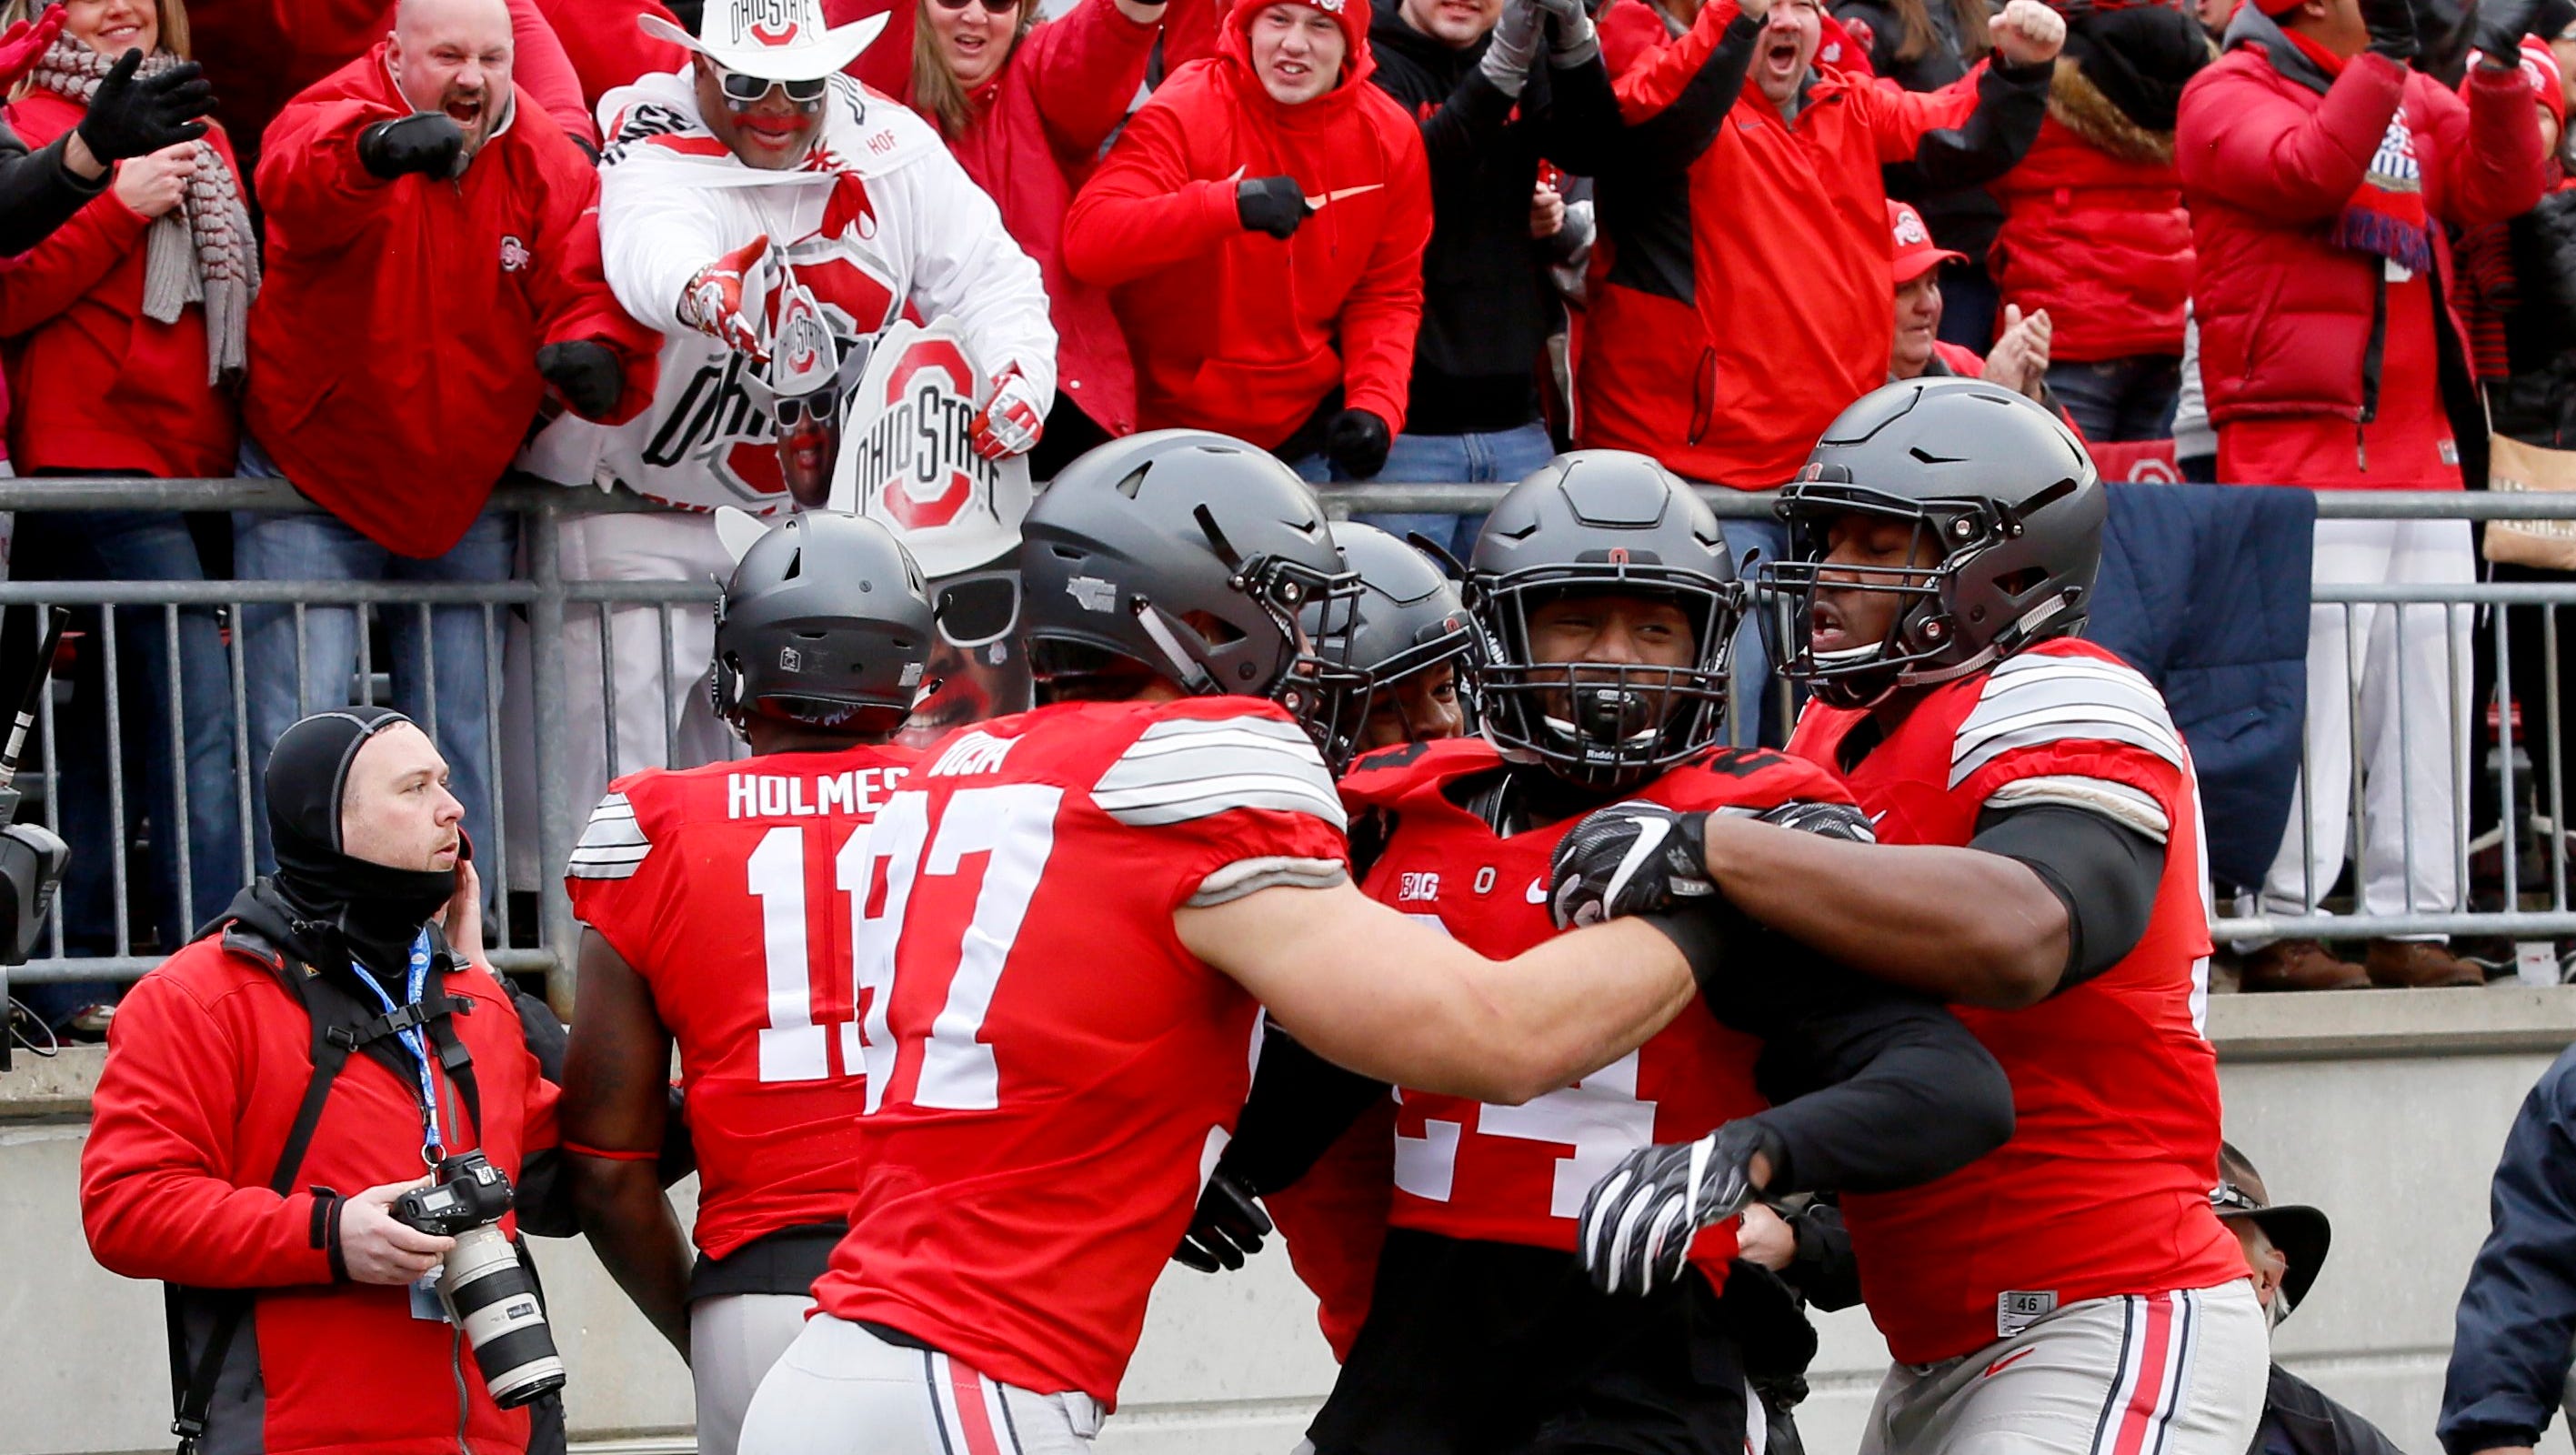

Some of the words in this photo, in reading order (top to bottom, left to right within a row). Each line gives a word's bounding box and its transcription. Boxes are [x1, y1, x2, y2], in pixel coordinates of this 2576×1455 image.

[866, 129, 897, 156] HOF
[855, 404, 912, 516] OHIO
[856, 783, 1065, 1117] 97
[2017, 1297, 2038, 1311] 46
